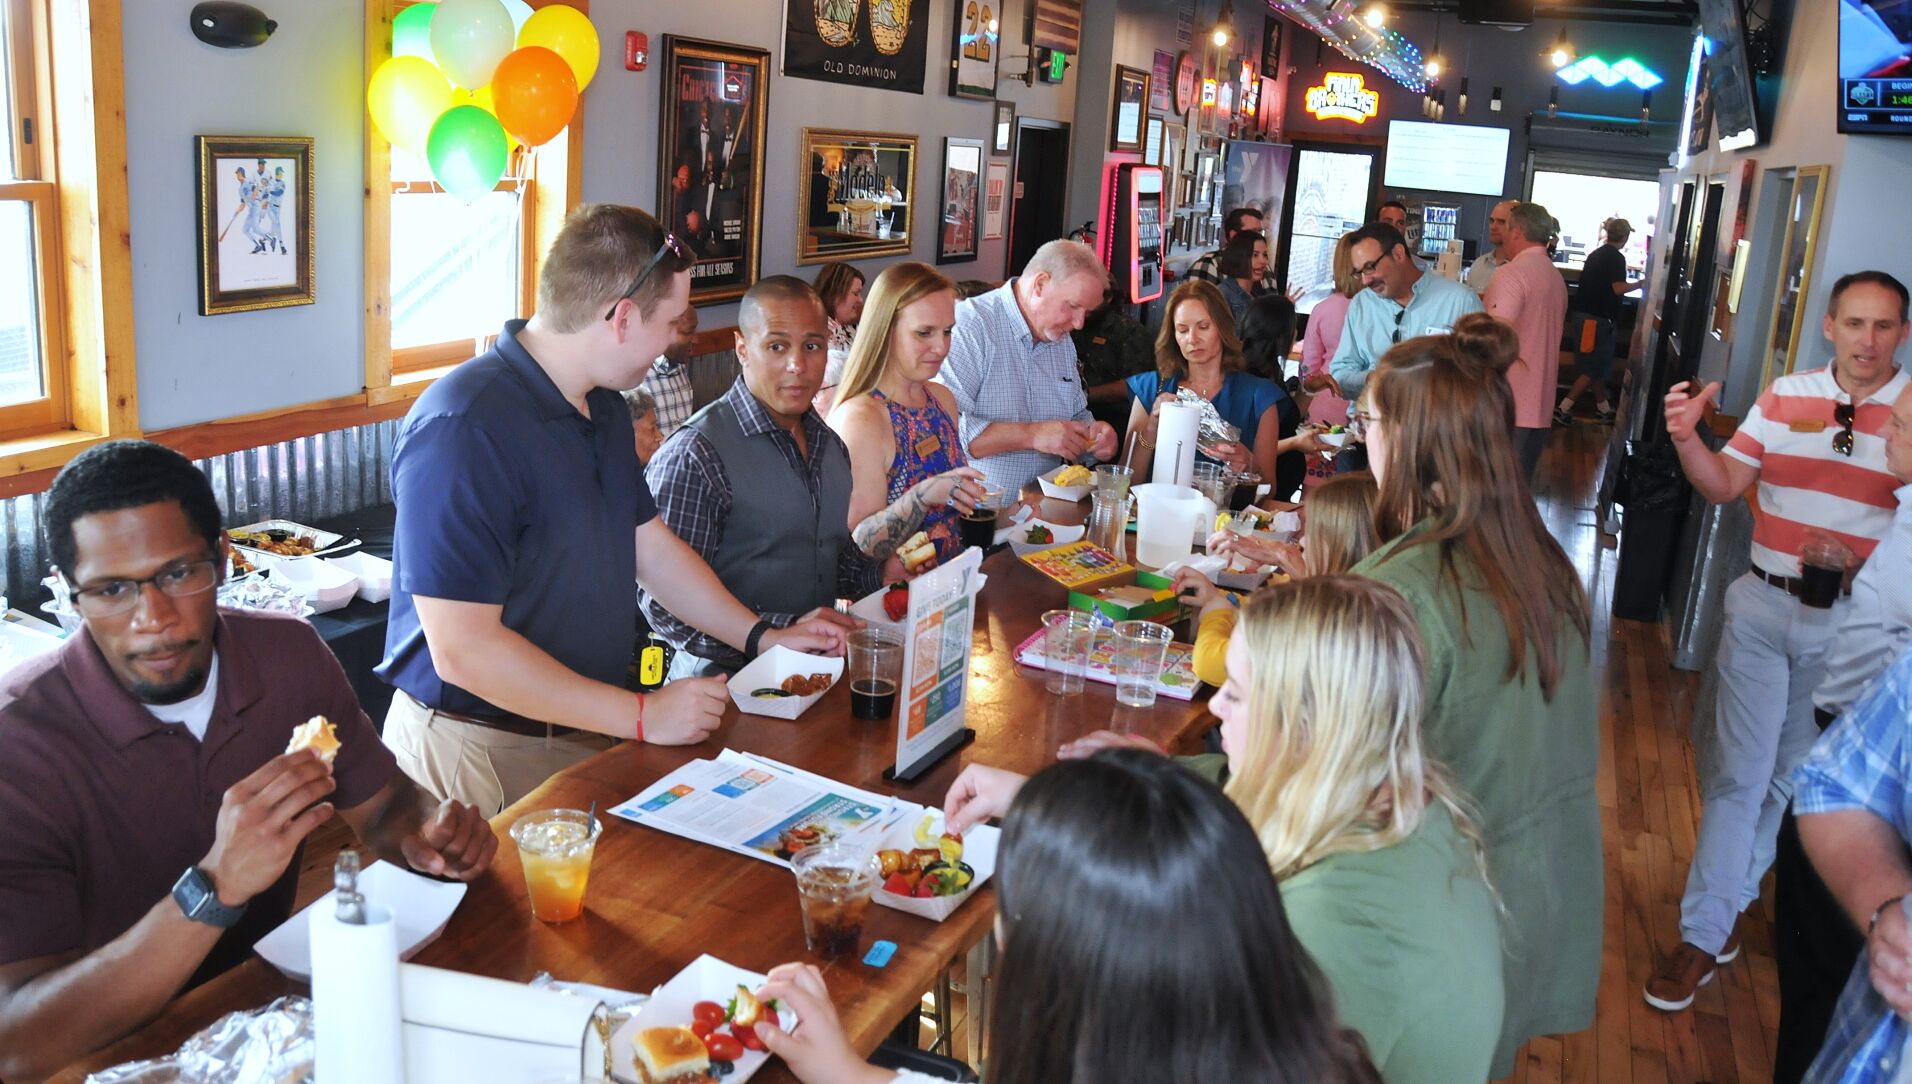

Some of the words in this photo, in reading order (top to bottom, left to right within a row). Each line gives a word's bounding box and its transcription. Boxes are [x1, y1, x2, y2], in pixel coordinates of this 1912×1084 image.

[963, 1, 992, 63] 22
[824, 60, 844, 74] OLD
[848, 63, 897, 80] DOMINION
